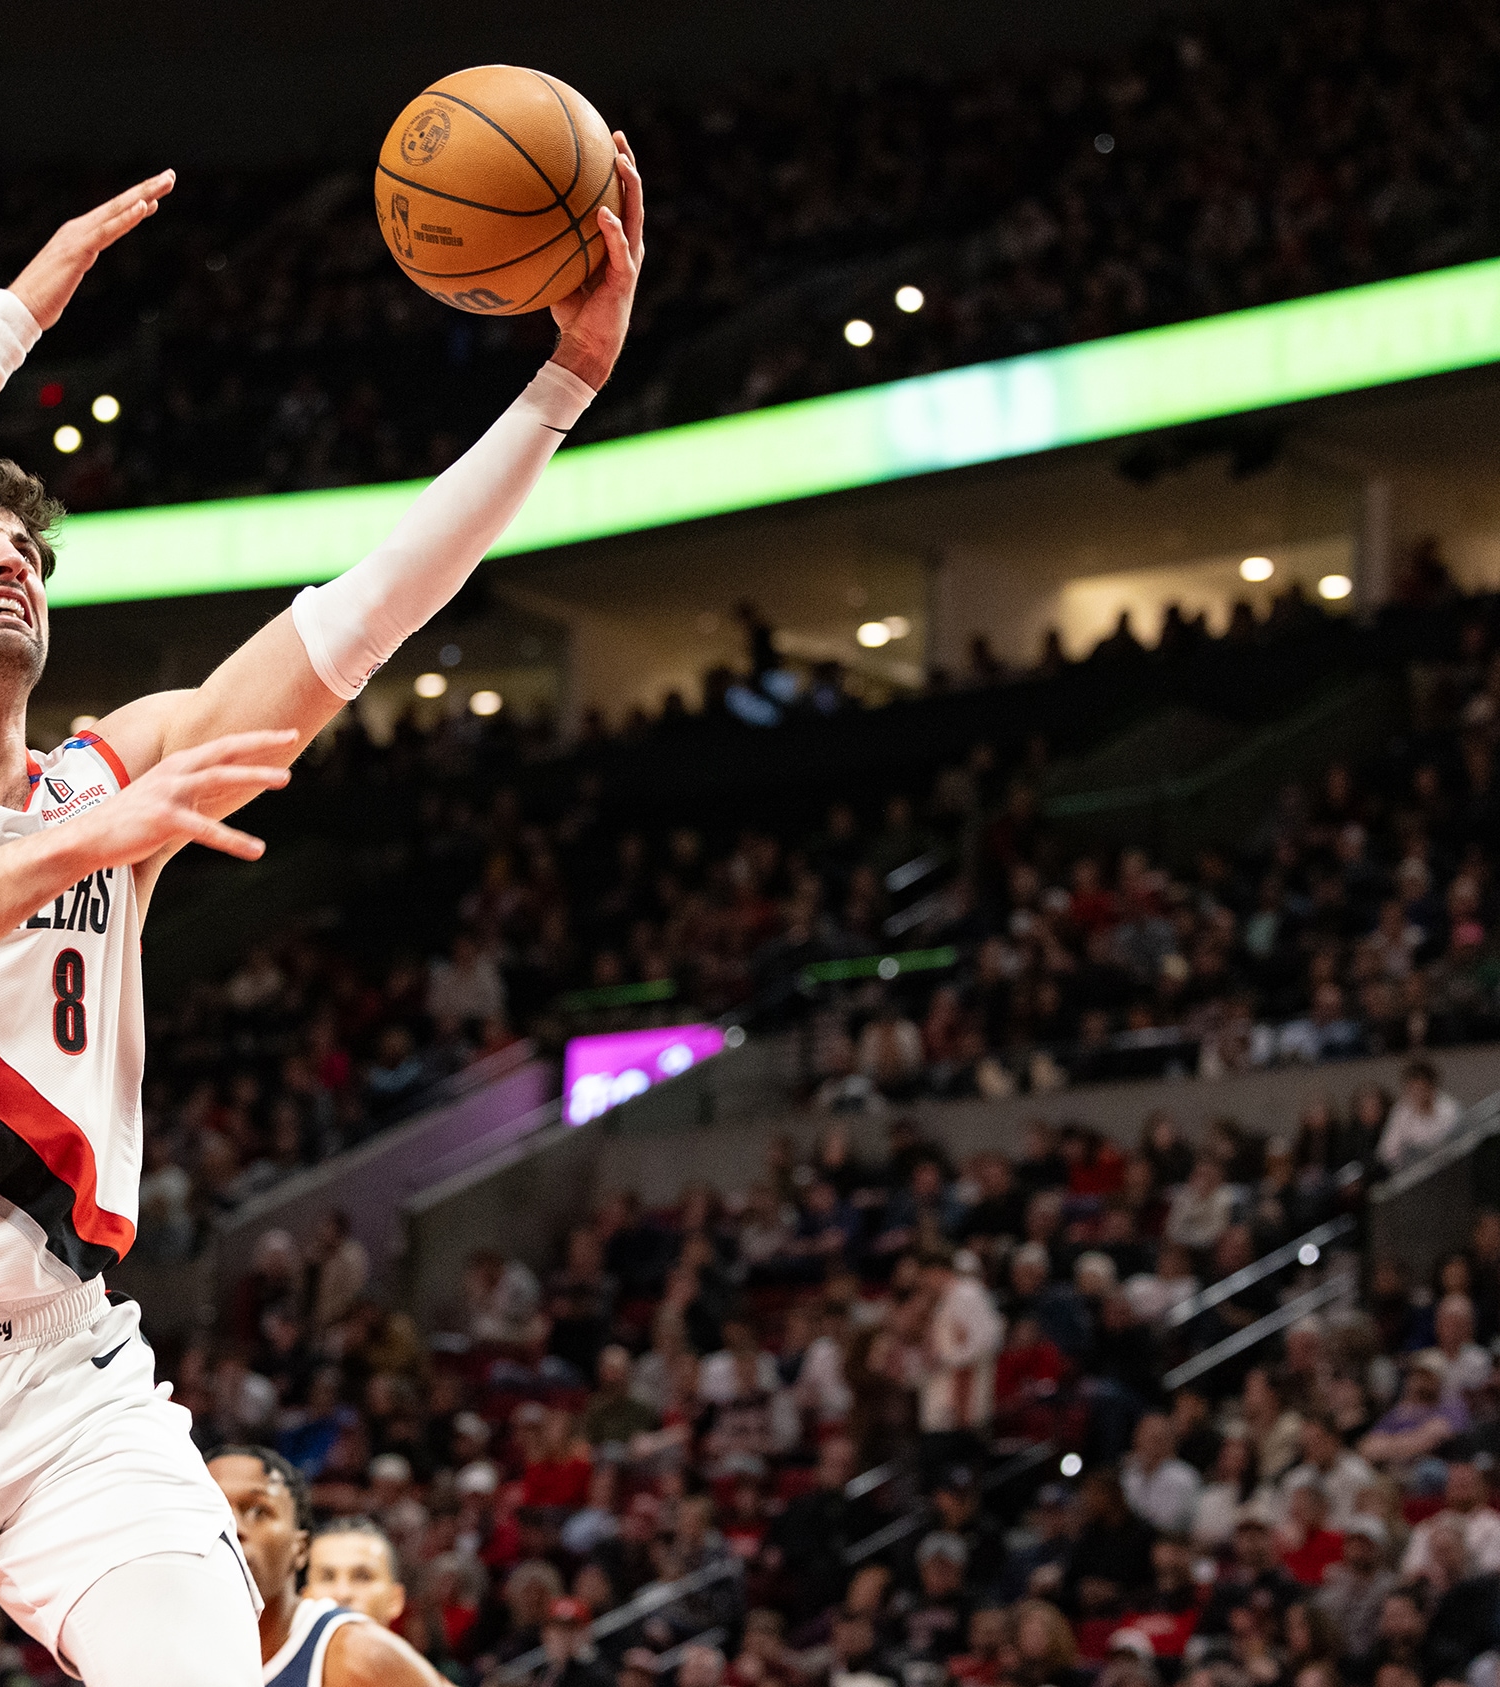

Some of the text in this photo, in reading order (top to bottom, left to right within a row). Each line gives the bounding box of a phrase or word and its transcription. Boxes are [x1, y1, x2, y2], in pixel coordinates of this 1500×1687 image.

[41, 784, 108, 821] BRIGHTSIDE
[53, 782, 69, 797] B
[57, 798, 101, 824] WINDOWS
[52, 947, 88, 1056] 8
